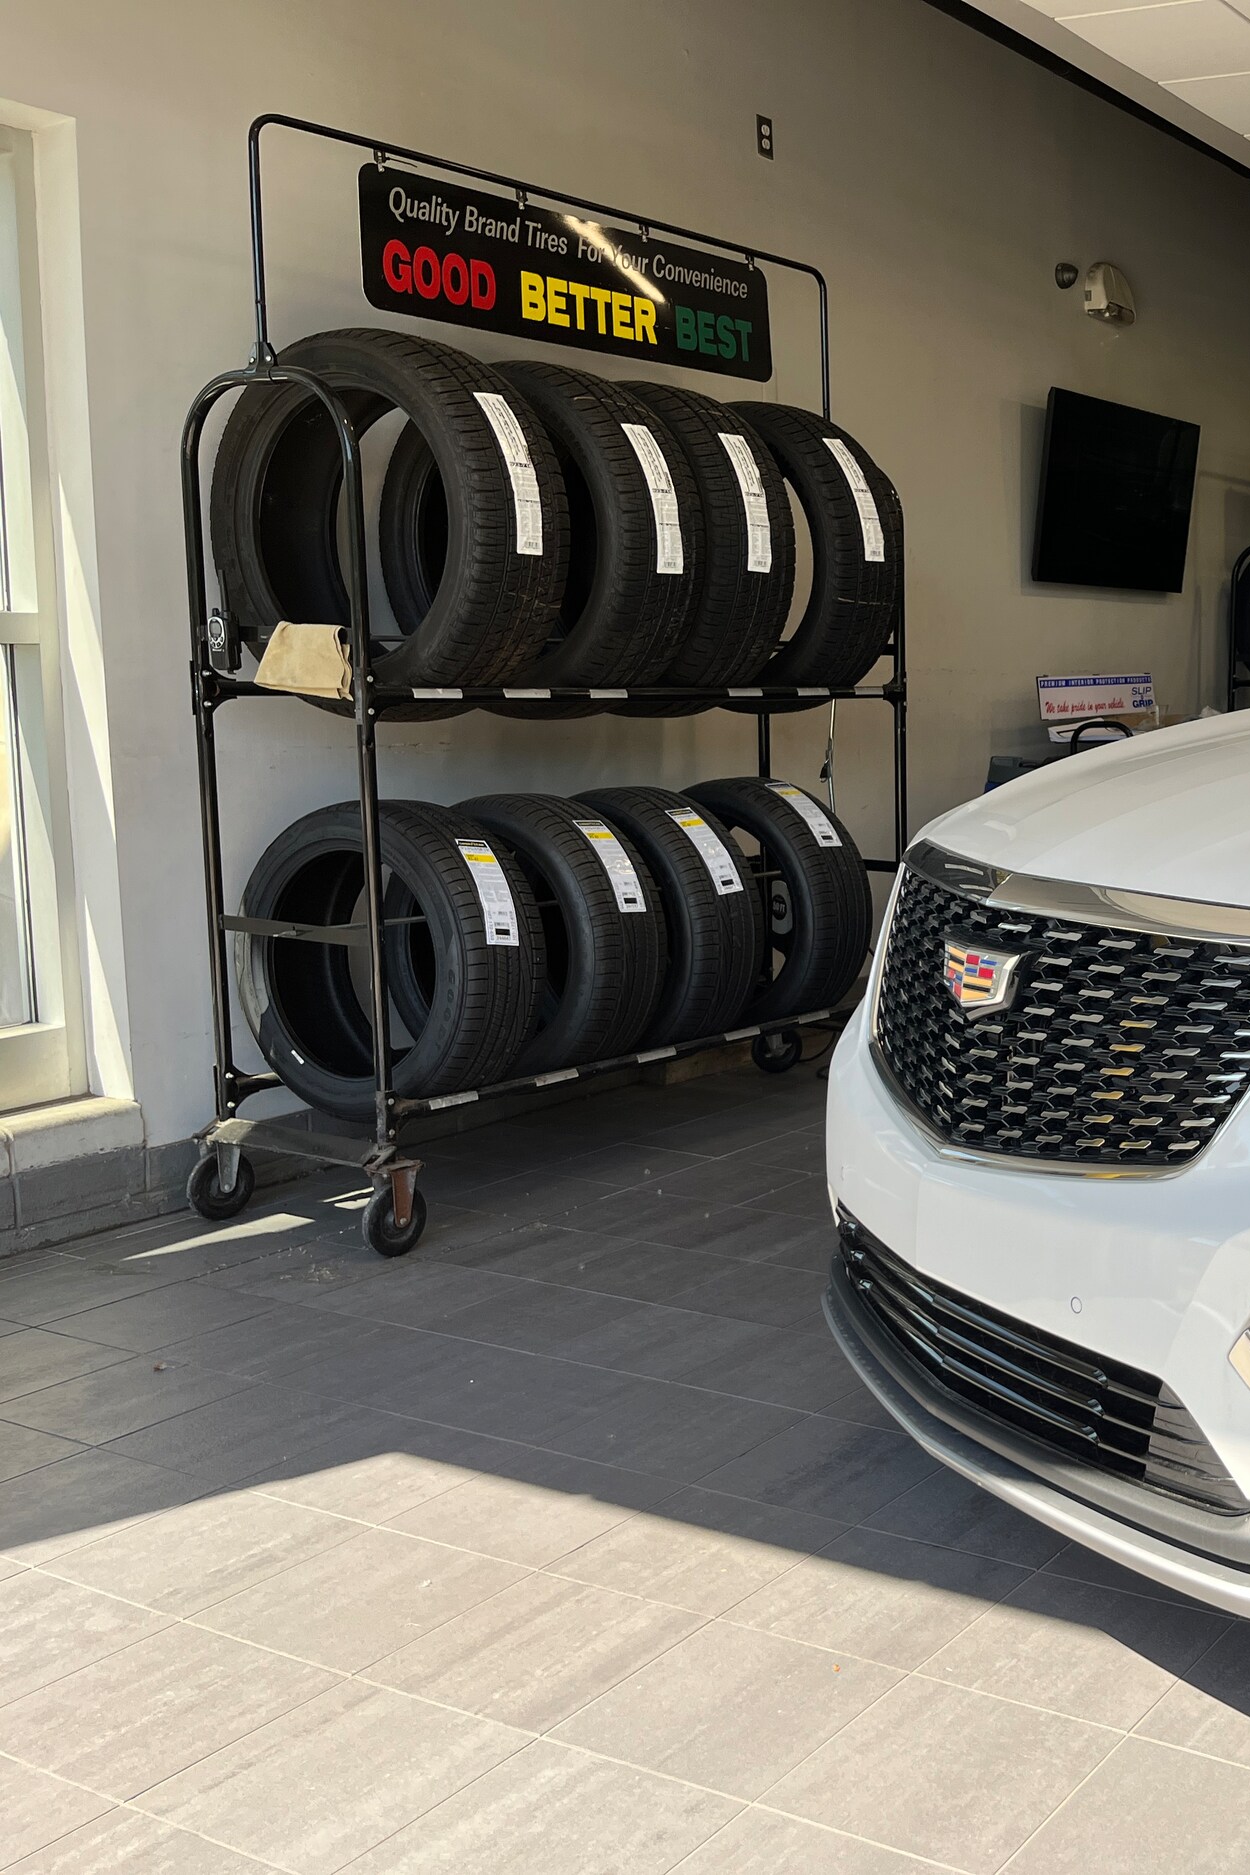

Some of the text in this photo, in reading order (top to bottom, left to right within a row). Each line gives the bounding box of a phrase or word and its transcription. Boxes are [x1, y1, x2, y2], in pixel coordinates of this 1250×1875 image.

[388, 186, 748, 299] Quality Brand Tires For Your Convenience
[382, 238, 753, 362] GOOD BETTER BEST
[1040, 679, 1066, 687] PREMIUM
[1095, 677, 1126, 685] PROTECTION
[1127, 675, 1152, 684] PRODUCTS
[1131, 686, 1152, 696] SLIP
[1071, 700, 1086, 715] pride
[1132, 699, 1154, 709] GRIP
